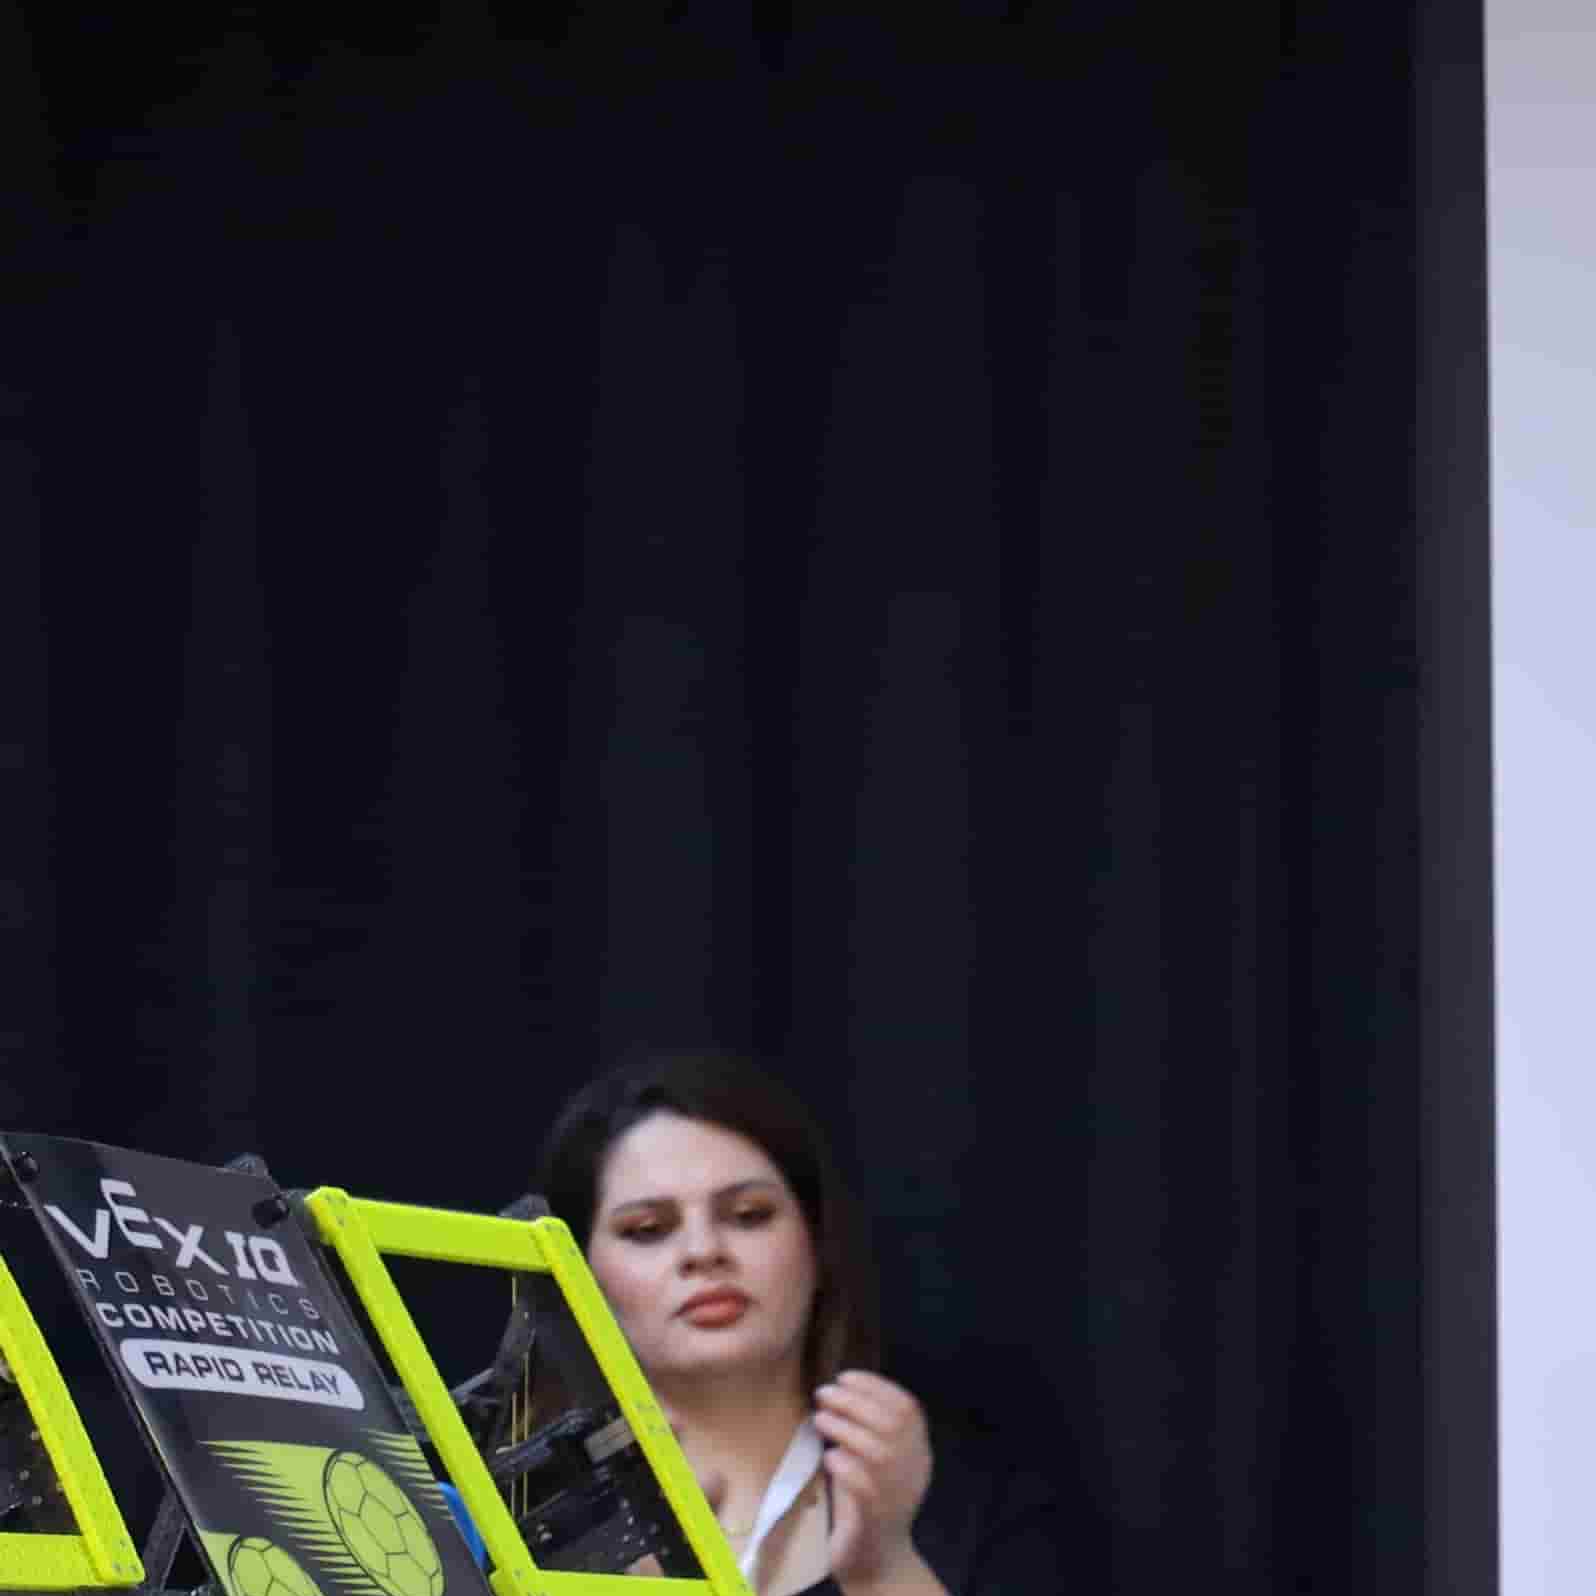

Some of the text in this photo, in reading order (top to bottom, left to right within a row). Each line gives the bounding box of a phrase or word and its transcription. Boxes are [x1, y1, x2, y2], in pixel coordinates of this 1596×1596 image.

[44, 1177, 302, 1289] VEX IQ
[75, 1267, 321, 1321] ROBOTICS
[95, 1302, 341, 1356] COMPETITION
[143, 1350, 344, 1397] RAPID RELAY
